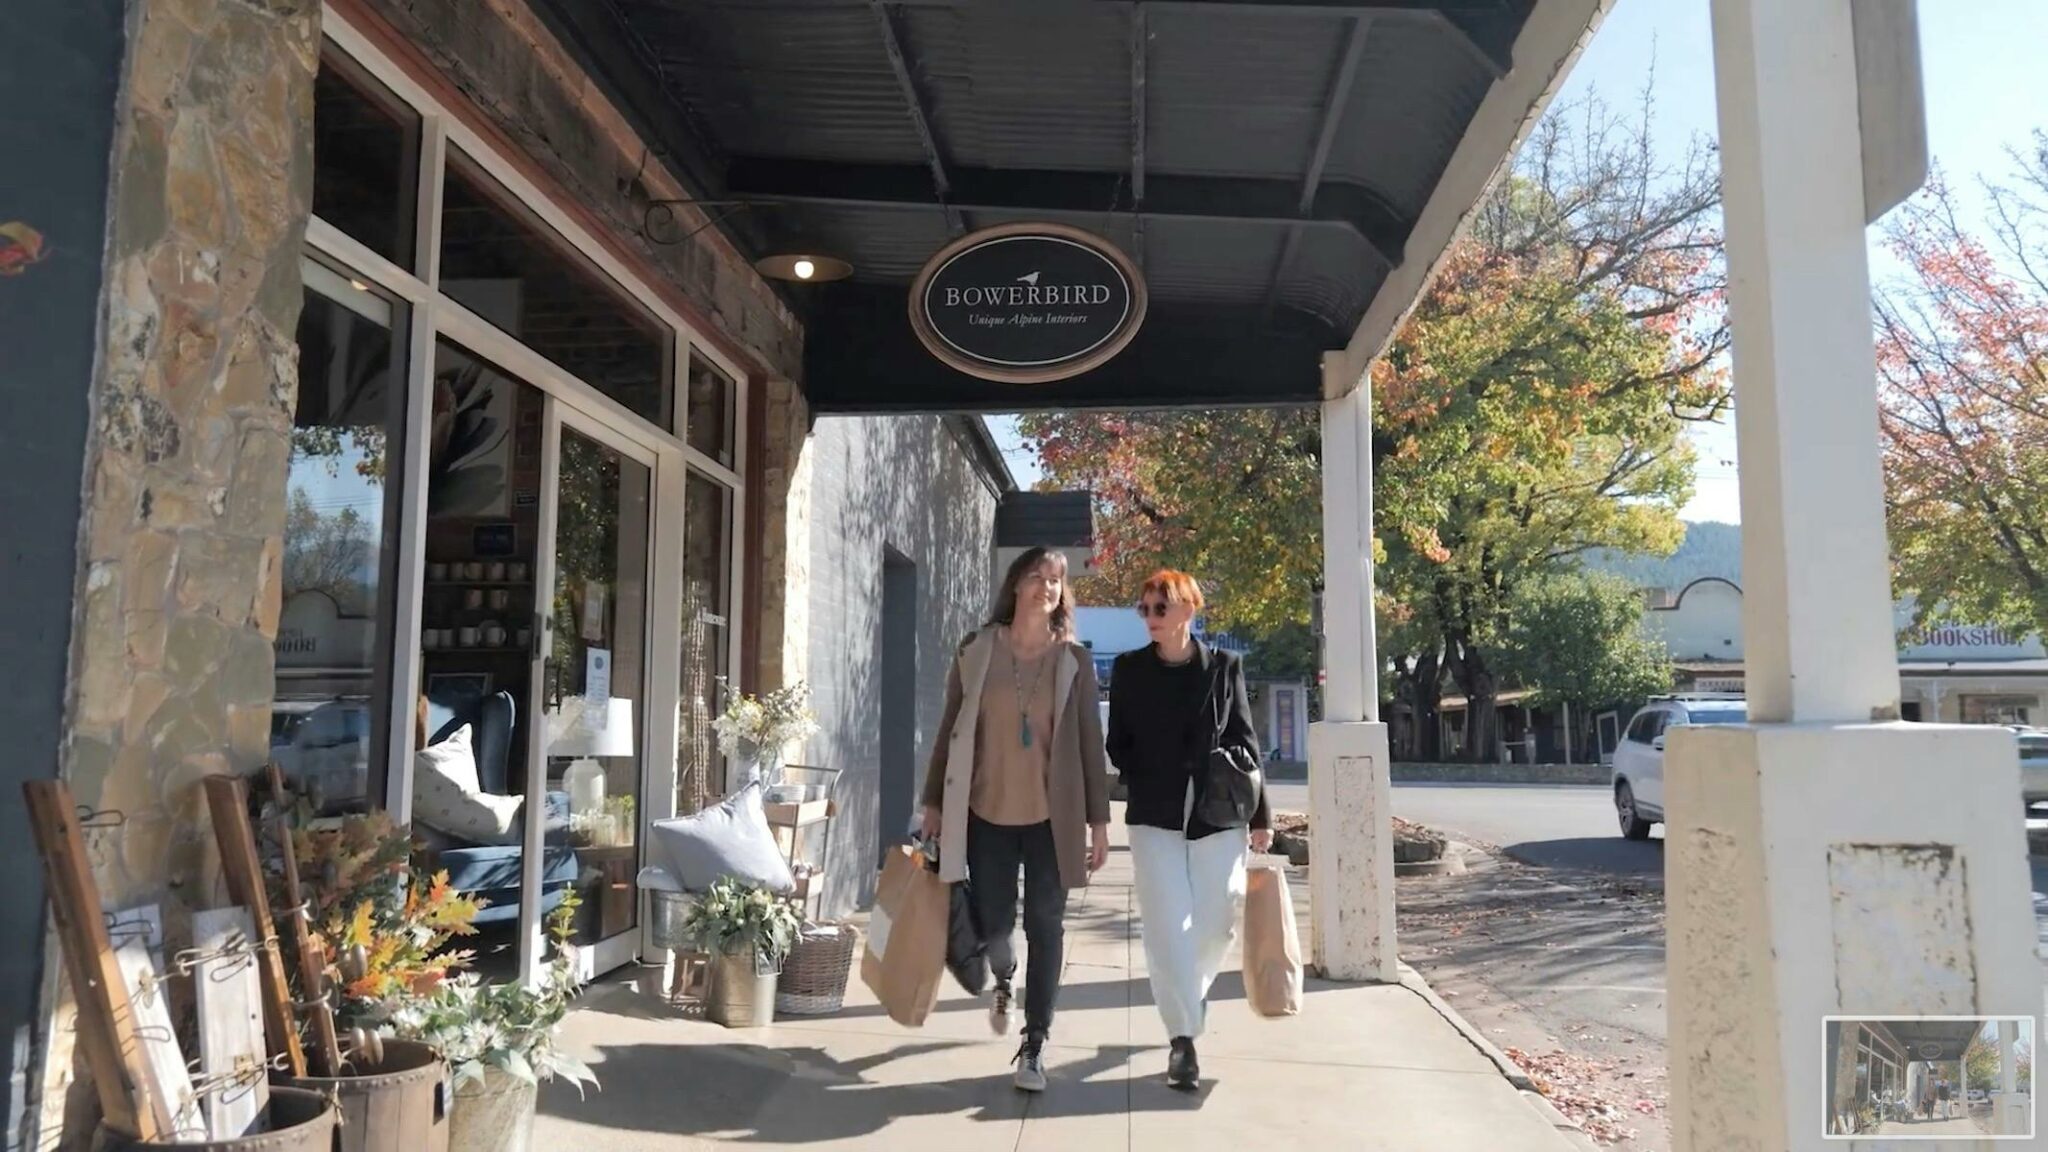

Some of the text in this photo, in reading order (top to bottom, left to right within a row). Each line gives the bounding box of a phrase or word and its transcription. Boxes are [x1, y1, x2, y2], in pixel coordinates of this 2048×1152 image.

[945, 284, 1110, 306] BOWERBIRD
[969, 312, 1087, 328] Unique Alpine Interiors
